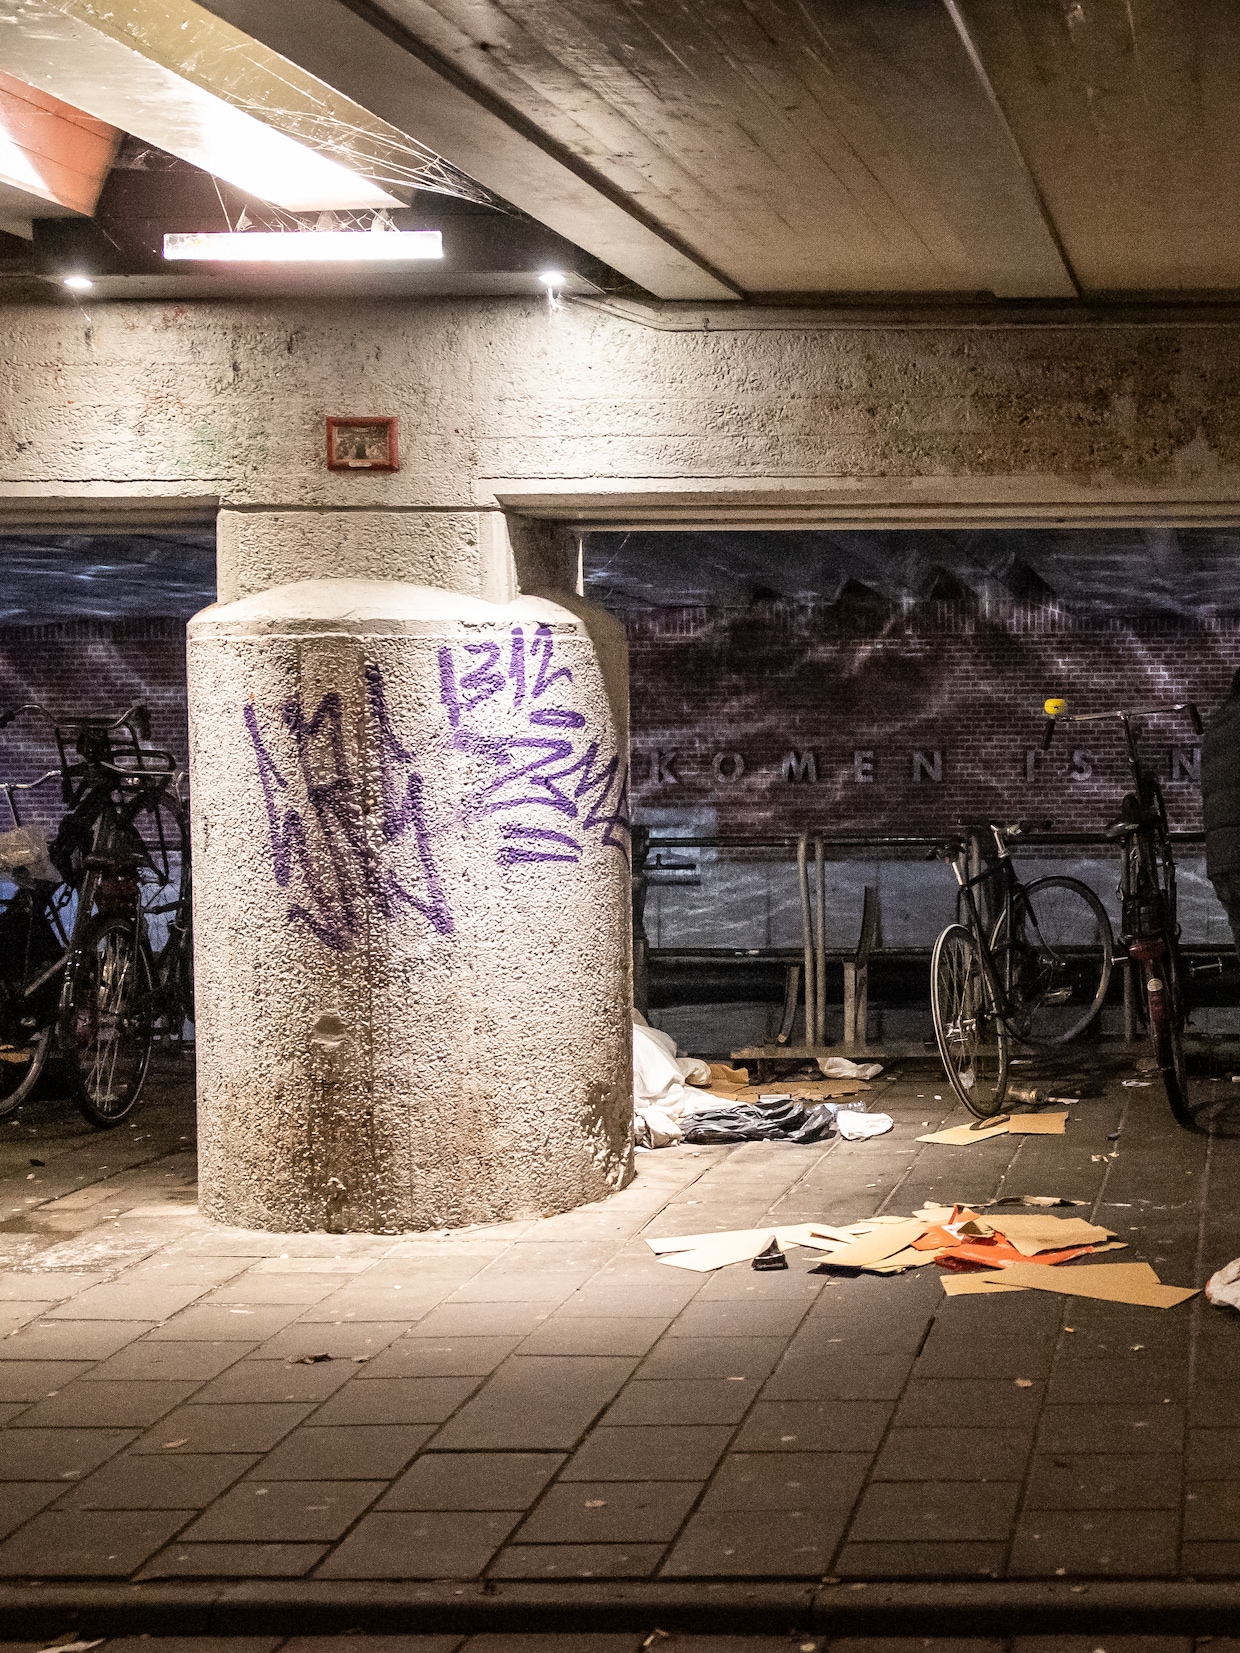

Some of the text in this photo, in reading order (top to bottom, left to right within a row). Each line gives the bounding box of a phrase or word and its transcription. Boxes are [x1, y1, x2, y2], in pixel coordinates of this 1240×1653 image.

[438, 627, 573, 727] 1312
[649, 749, 944, 784] KOMEN
[1026, 747, 1093, 782] IS
